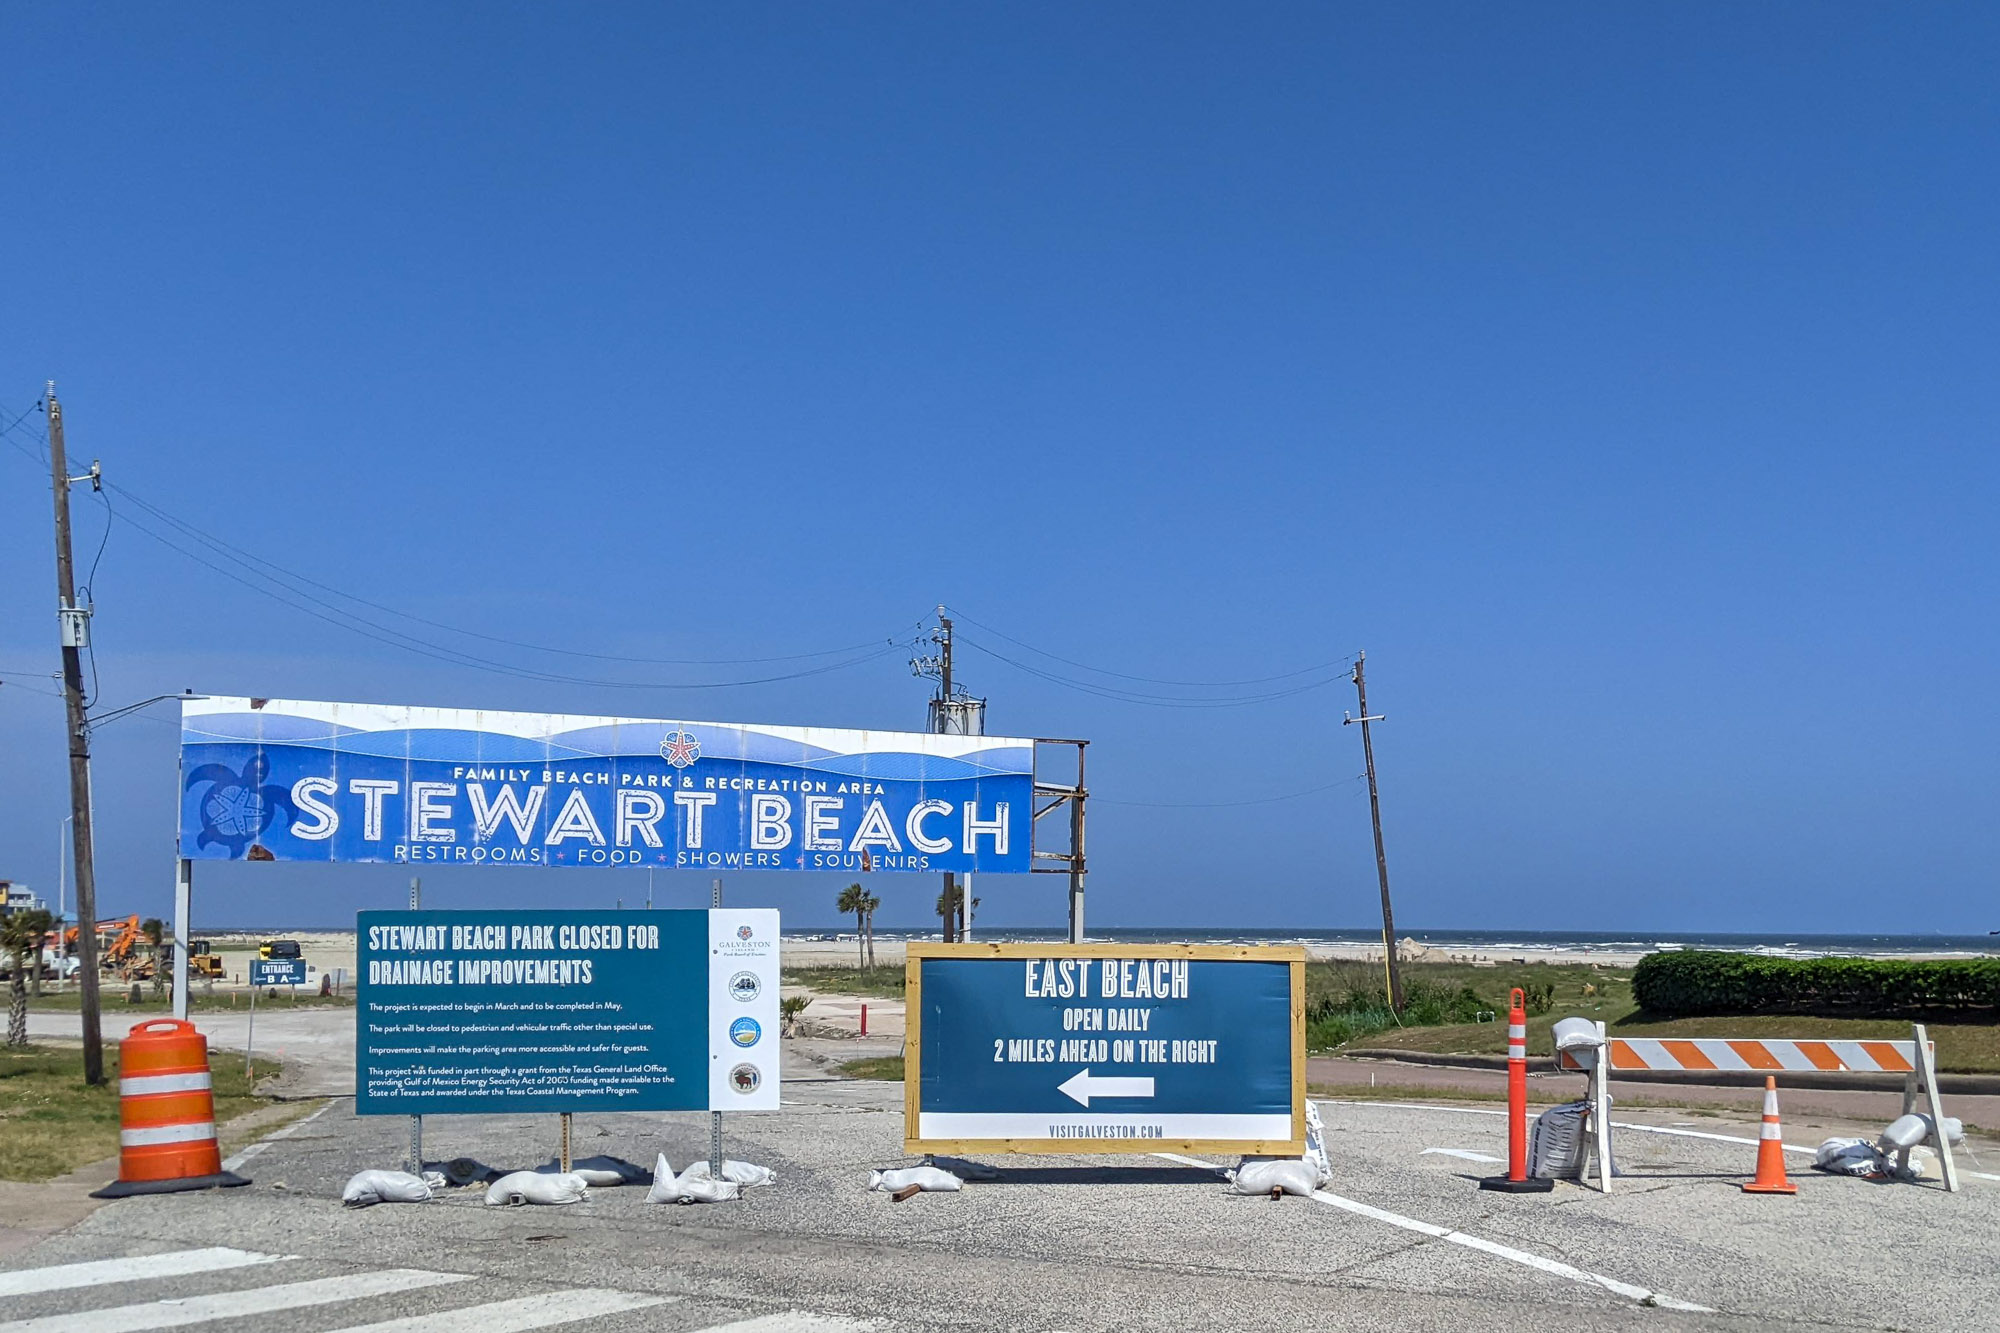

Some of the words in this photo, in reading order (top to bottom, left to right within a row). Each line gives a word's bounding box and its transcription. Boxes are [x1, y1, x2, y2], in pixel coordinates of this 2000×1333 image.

[454, 767, 531, 782] FAMILY
[542, 771, 609, 785] BEACH
[622, 774, 673, 788] PARK
[682, 776, 694, 788] &
[705, 777, 827, 793] RECREATION
[837, 782, 885, 795] AREA
[291, 776, 717, 849] STEWART
[750, 793, 1009, 855] BEACH
[395, 845, 541, 862] RESTROOMS
[578, 849, 642, 864] FOOD
[677, 851, 781, 866] SHOWERS
[368, 925, 448, 951] STEWART
[452, 925, 506, 951] BEACH
[511, 925, 555, 950] PARK
[560, 925, 622, 950] CLOSED
[627, 925, 659, 950] FOR
[261, 964, 294, 974] ENTRANCE
[369, 960, 454, 985] DRAINAGE
[458, 959, 593, 985] IMPROVEMENTS
[267, 975, 275, 983] B
[280, 974, 289, 983] A
[1025, 958, 1093, 998] EAST
[1101, 958, 1189, 999] BEACH
[369, 1003, 383, 1011] The
[384, 1002, 411, 1013] project
[412, 1003, 418, 1011] is
[420, 1002, 453, 1013] expected
[454, 1003, 463, 1011] to
[464, 1002, 484, 1013] begin
[486, 1002, 493, 1010] in
[494, 1002, 519, 1010] March
[520, 1002, 534, 1010] and
[544, 1002, 554, 1010] be
[556, 1002, 594, 1012] completed
[604, 1002, 623, 1012] May.
[1063, 1008, 1103, 1031] OPEN
[1107, 1008, 1151, 1031] DAILY
[369, 1024, 383, 1032] The
[384, 1024, 401, 1035] park
[402, 1024, 415, 1032] will
[416, 1024, 425, 1032] be
[426, 1024, 450, 1032] closed
[451, 1024, 460, 1032] to
[461, 1024, 499, 1035] pedestrian
[500, 1024, 514, 1032] and
[516, 1023, 548, 1031] vehicular
[550, 1023, 572, 1031] traffic
[573, 1023, 594, 1031] other
[595, 1023, 612, 1031] than
[613, 1023, 638, 1033] special
[369, 1046, 422, 1056] Improvements
[423, 1045, 436, 1053] will
[437, 1045, 457, 1053] make
[459, 1045, 471, 1053] the
[472, 1045, 500, 1056] parking
[539, 1045, 575, 1053] accessible
[577, 1044, 591, 1052] and
[592, 1044, 610, 1052] safer
[611, 1044, 622, 1052] for
[623, 1044, 649, 1054] guests.
[994, 1039, 1003, 1062] 2
[1008, 1039, 1055, 1062] MILES
[1059, 1040, 1108, 1063] AHEAD
[1113, 1040, 1134, 1063] ON
[1138, 1040, 1167, 1063] THE
[1171, 1040, 1217, 1063] RIGHT
[369, 1067, 384, 1075] This
[385, 1067, 411, 1077] project
[413, 1067, 427, 1075] was
[428, 1066, 453, 1075] funded
[455, 1067, 462, 1075] in
[464, 1067, 479, 1077] part
[481, 1066, 510, 1077] through
[517, 1067, 537, 1077] grant
[539, 1066, 557, 1074] from
[558, 1066, 571, 1074] the
[573, 1065, 592, 1073] Texas
[593, 1065, 623, 1073] General
[624, 1065, 642, 1073] Land
[643, 1065, 667, 1073] Office
[368, 1078, 402, 1089] providing
[404, 1078, 421, 1086] Gulf
[422, 1078, 431, 1086] of
[432, 1078, 460, 1086] Mexico
[461, 1078, 487, 1088] Energy
[489, 1077, 519, 1087] Security
[521, 1077, 535, 1085] Act
[537, 1077, 545, 1085] of
[570, 1077, 598, 1086] funding
[599, 1076, 619, 1084] made
[620, 1076, 651, 1084] available
[662, 1075, 675, 1083] the
[368, 1089, 388, 1097] State
[390, 1089, 398, 1097] of
[400, 1089, 419, 1097] Texas
[420, 1089, 435, 1097] and
[468, 1088, 490, 1096] under
[491, 1088, 504, 1096] the
[506, 1087, 525, 1095] Texas
[526, 1087, 554, 1096] Coastal
[556, 1087, 604, 1097] Management
[605, 1086, 639, 1096] Program.
[1049, 1125, 1163, 1138] VISITGALVESTON.COM
